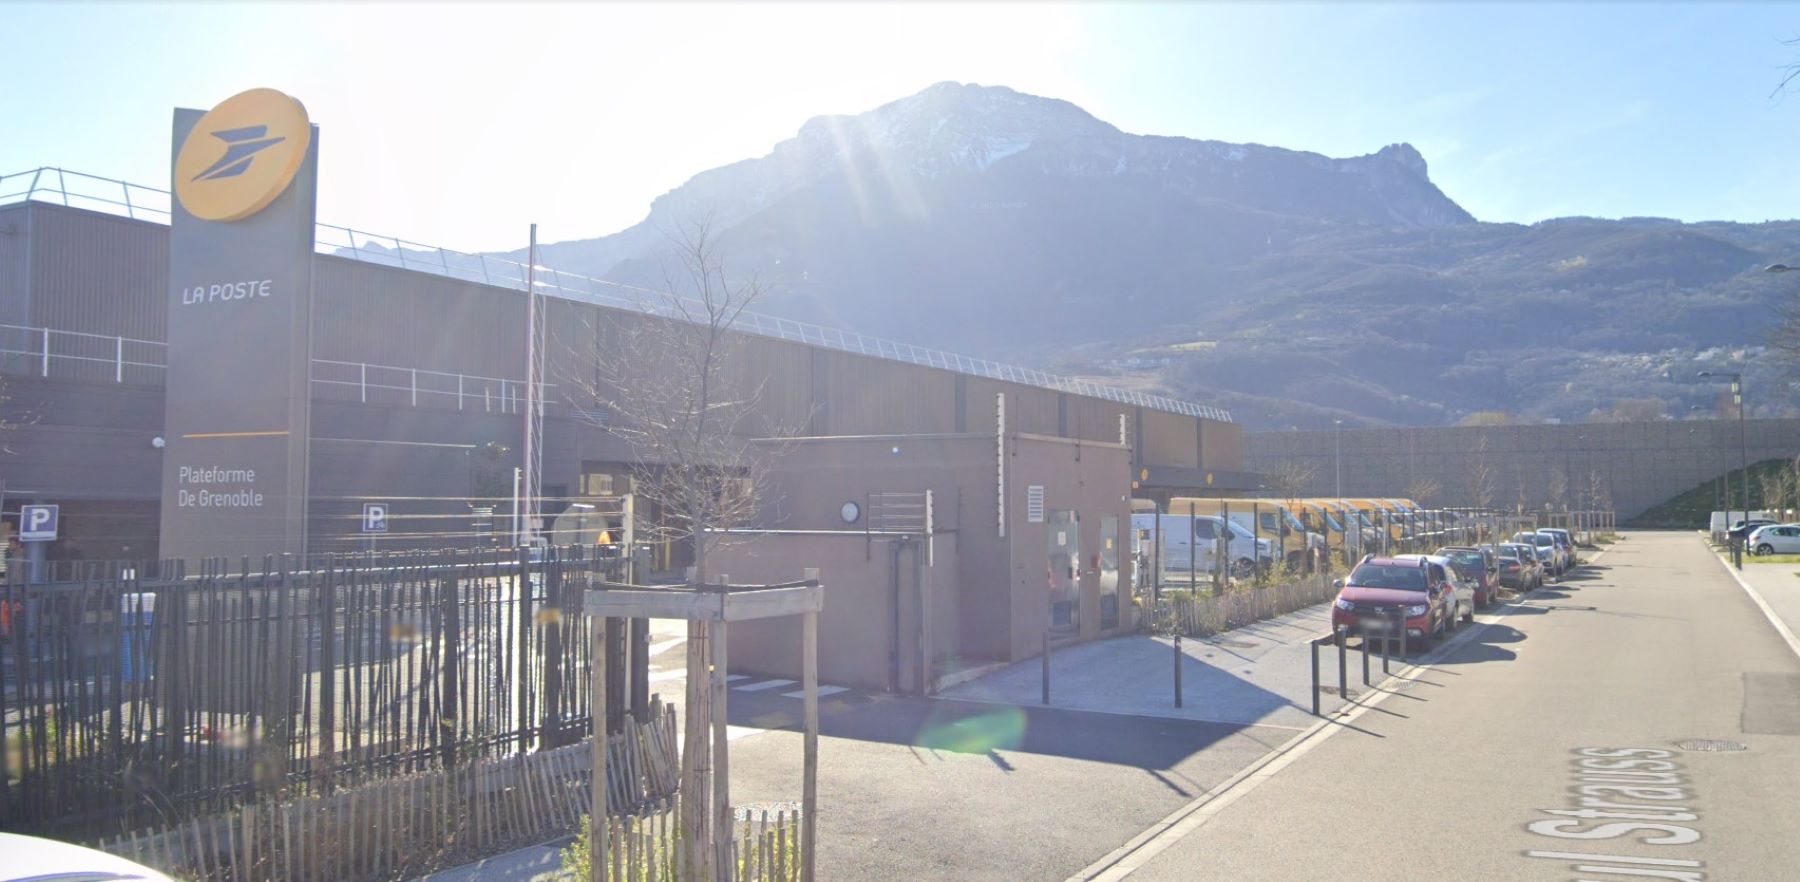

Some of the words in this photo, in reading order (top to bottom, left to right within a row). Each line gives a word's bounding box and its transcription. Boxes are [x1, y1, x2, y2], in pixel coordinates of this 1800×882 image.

[182, 286, 205, 305] LA
[208, 279, 273, 302] POSTE
[179, 465, 255, 483] Plateforme
[178, 489, 196, 507] De
[198, 488, 264, 507] Grenoble
[31, 508, 51, 531] P
[368, 506, 385, 529] P
